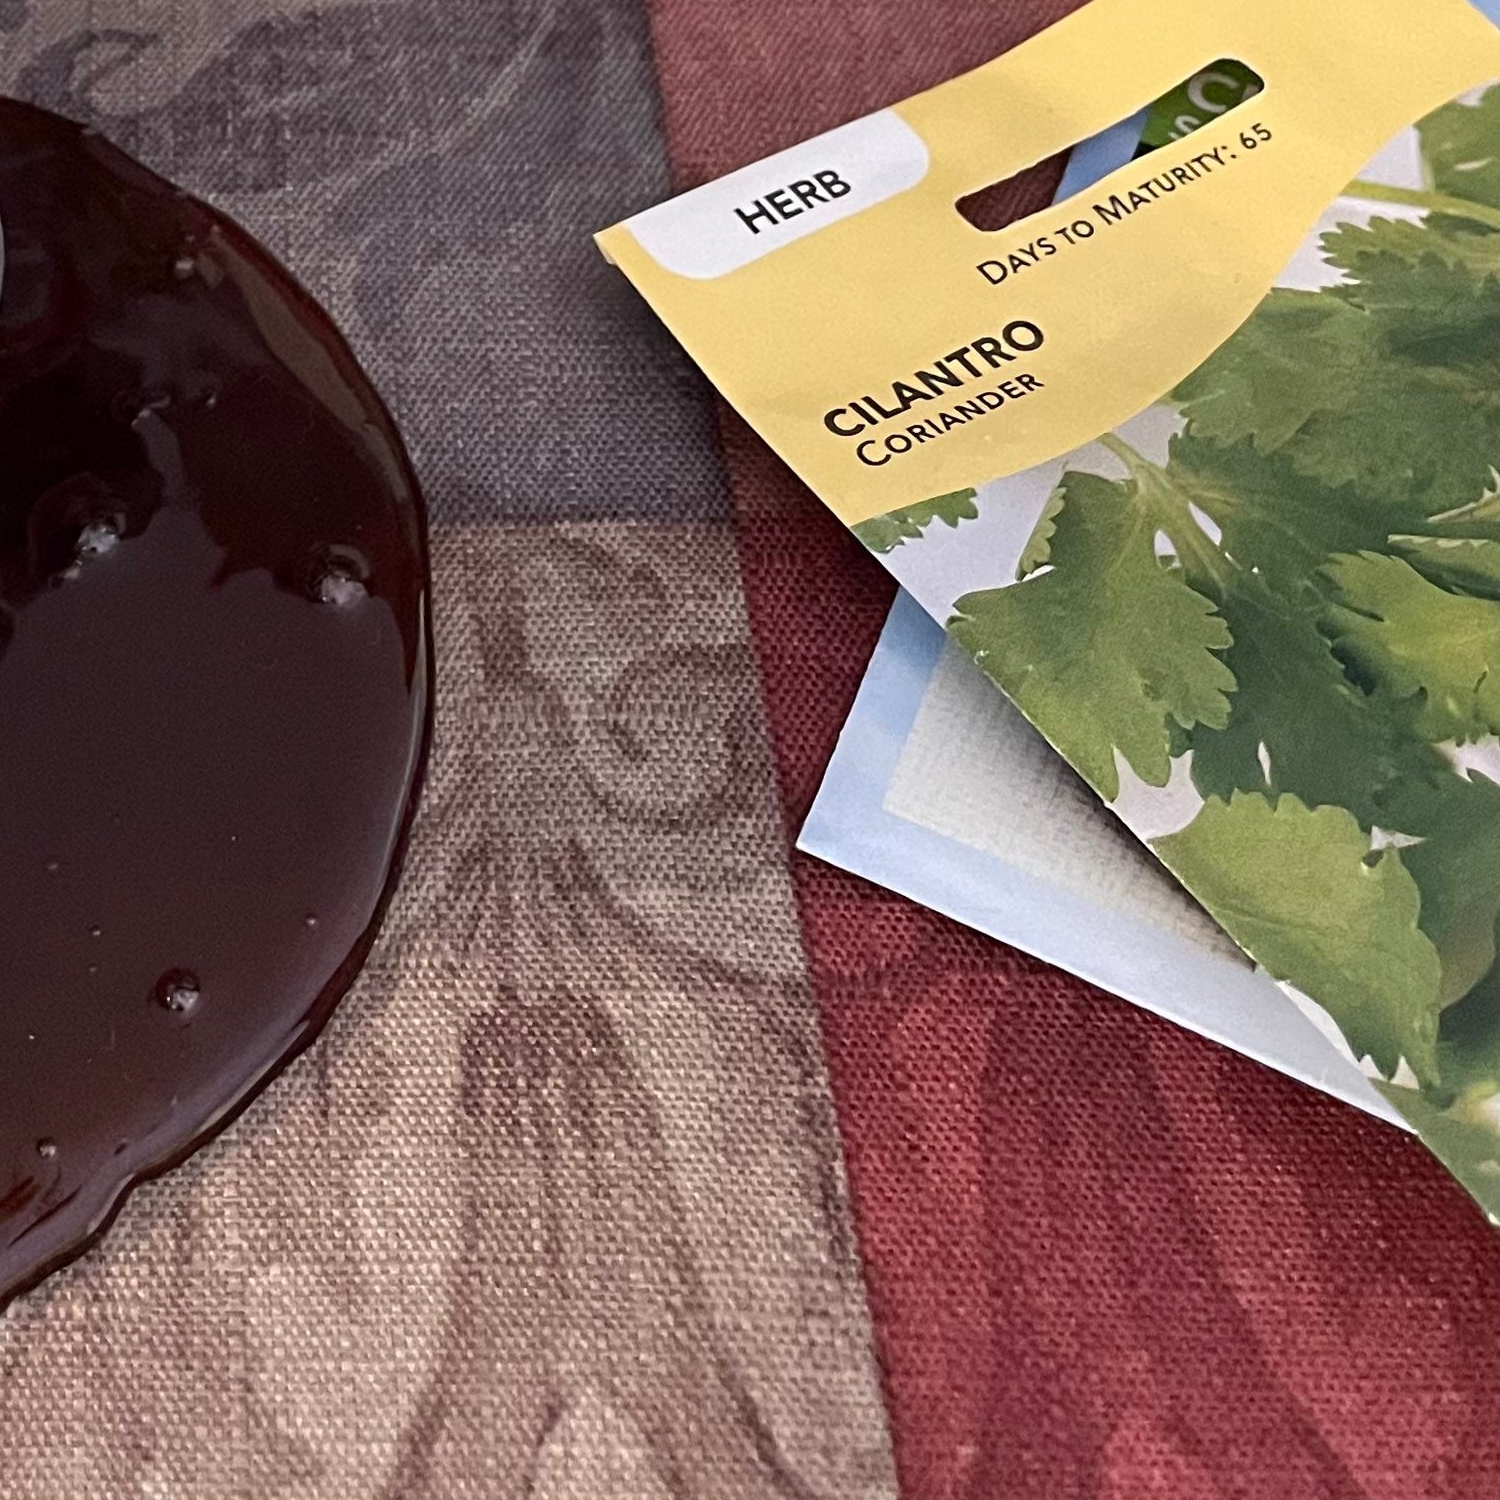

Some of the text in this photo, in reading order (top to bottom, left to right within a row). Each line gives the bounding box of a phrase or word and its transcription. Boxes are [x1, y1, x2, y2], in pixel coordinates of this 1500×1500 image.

[733, 169, 852, 234] HERB
[976, 237, 1057, 285] DAYS
[1054, 219, 1095, 245] TO
[1092, 145, 1237, 226] MATURITY:
[1239, 122, 1273, 150] 65
[823, 320, 1045, 437] CILANTRO
[856, 373, 1045, 467] CORIANDER
